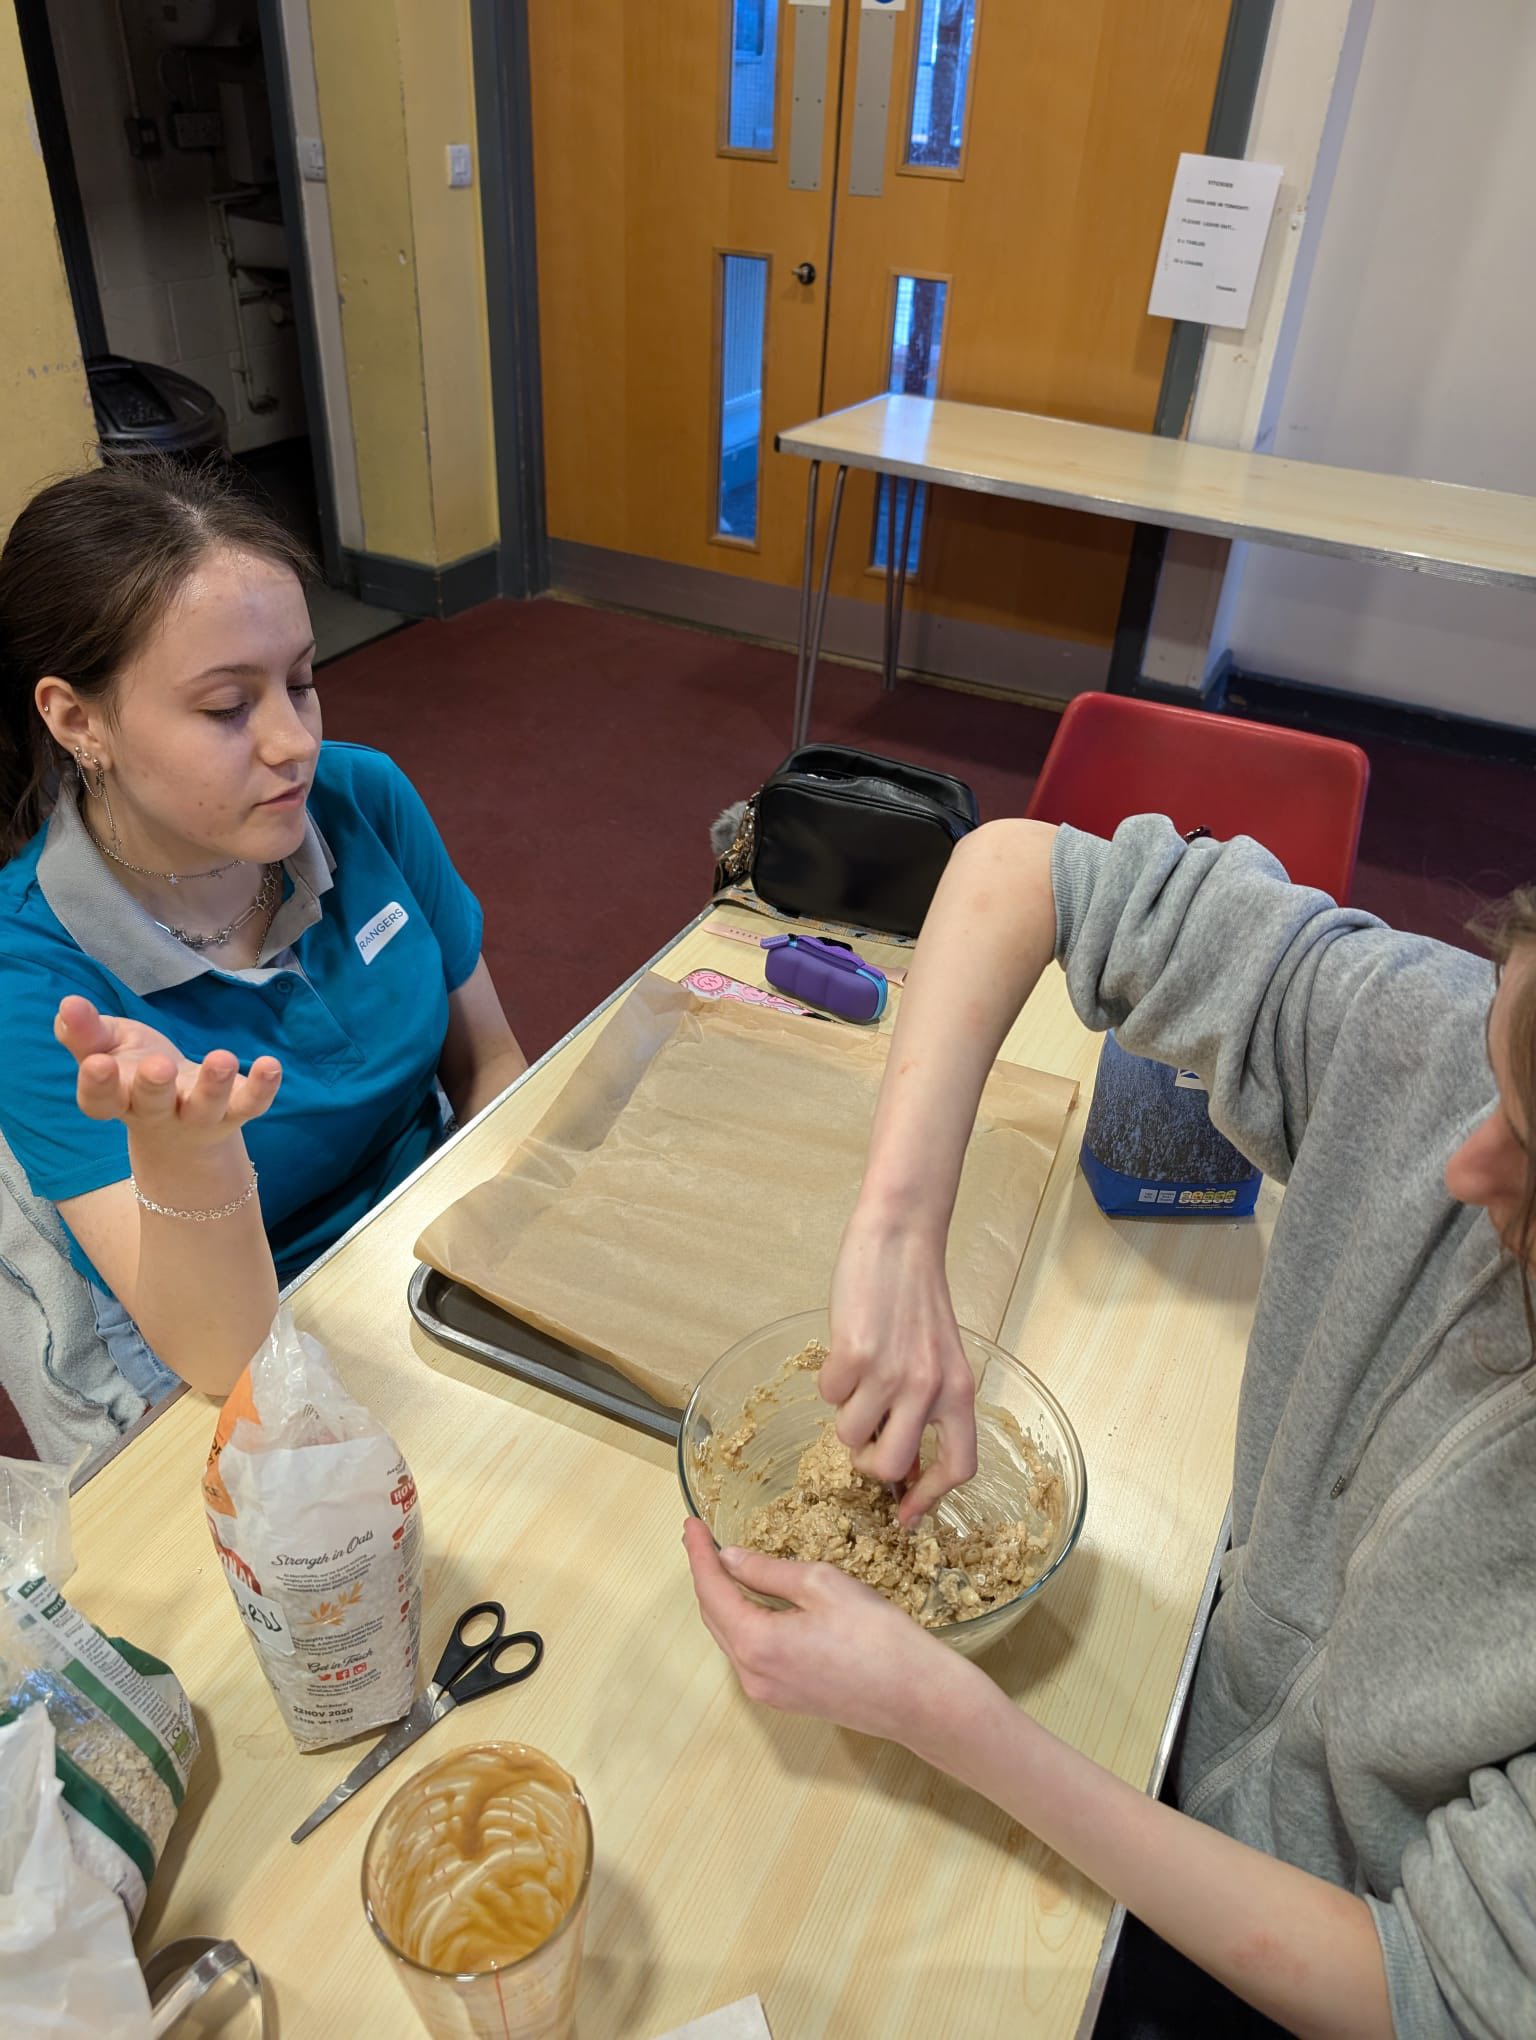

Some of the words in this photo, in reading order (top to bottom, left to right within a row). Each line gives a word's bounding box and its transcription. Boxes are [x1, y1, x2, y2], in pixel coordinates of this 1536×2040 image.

[359, 908, 404, 951] RANGERS
[271, 1553, 328, 1570] Strength
[332, 1549, 344, 1560] in
[346, 1530, 374, 1554] Oats
[306, 1662, 330, 1674] Get
[330, 1661, 341, 1670] in
[343, 1648, 374, 1667] Touch
[293, 1705, 325, 1718] 22NOV
[328, 1707, 354, 1717] 2020
